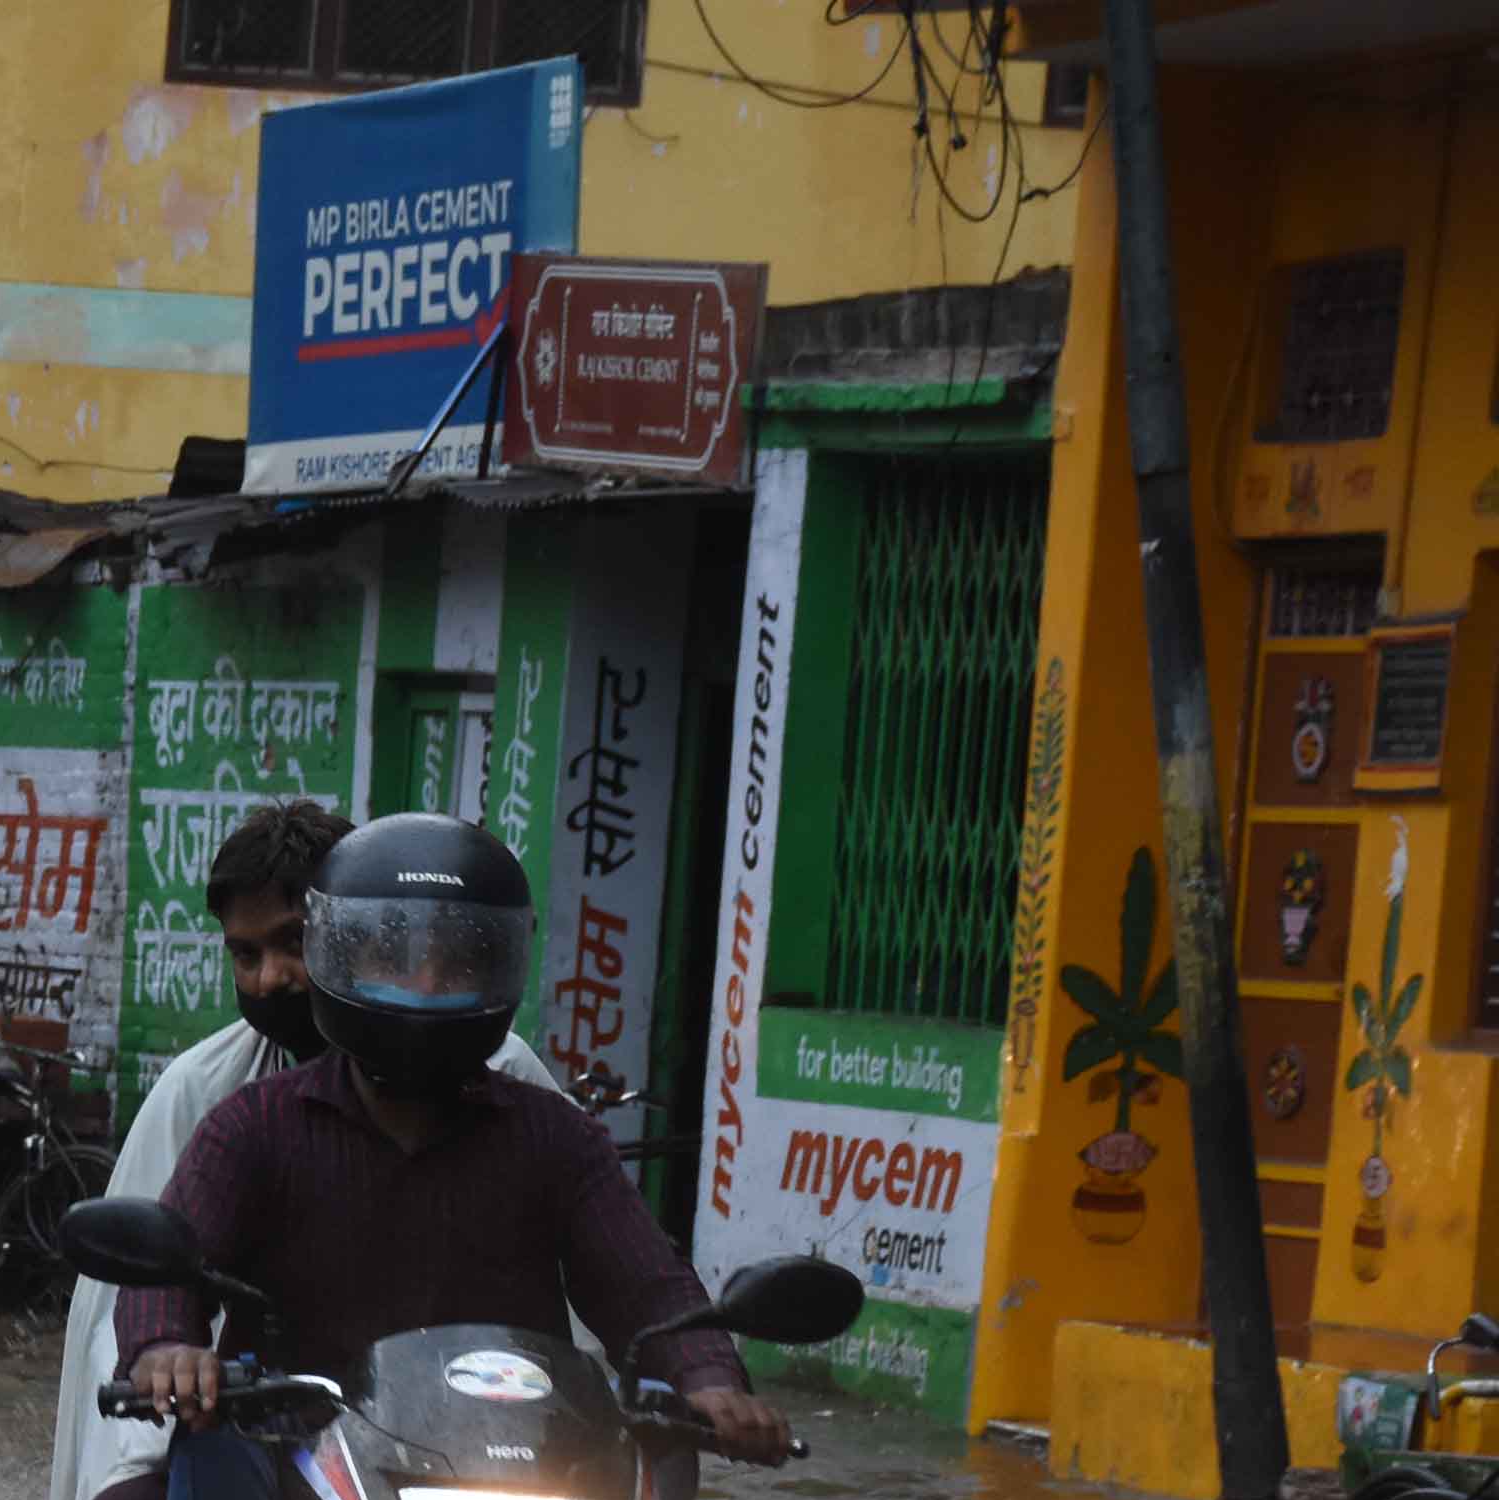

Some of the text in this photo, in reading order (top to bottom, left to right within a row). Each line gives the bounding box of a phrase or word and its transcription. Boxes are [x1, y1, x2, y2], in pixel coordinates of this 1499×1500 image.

[306, 179, 513, 248] MP BIRLA CEMENT
[303, 232, 512, 337] PERFECT
[637, 356, 680, 383] CEMENT
[296, 455, 325, 481] RAM
[329, 451, 390, 480] KISHORE
[202, 654, 246, 744] की
[251, 680, 340, 778] दुकान
[396, 871, 466, 888] HONDA
[712, 592, 779, 1219] mycem cement
[796, 1034, 963, 1111] for better building
[779, 1130, 963, 1217] mycem
[863, 1226, 946, 1274] cement
[485, 1445, 535, 1460] Hero
